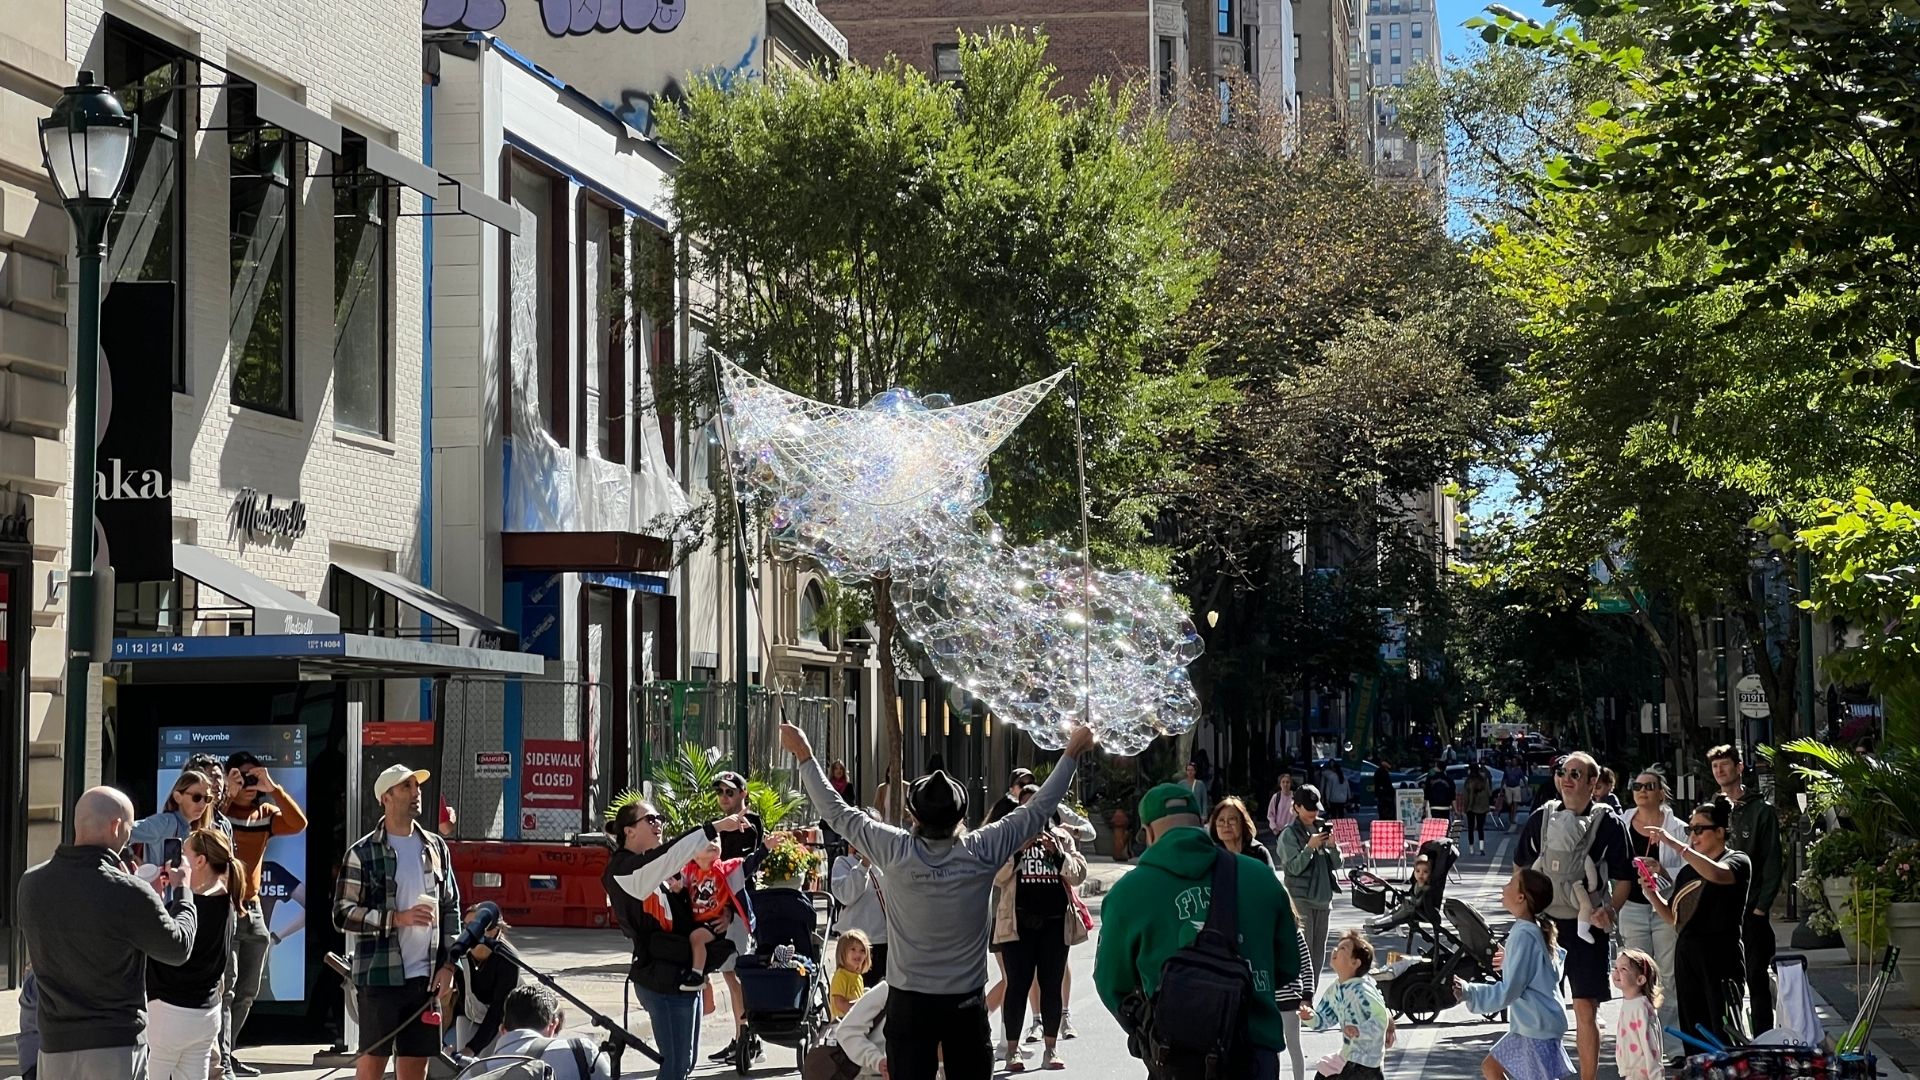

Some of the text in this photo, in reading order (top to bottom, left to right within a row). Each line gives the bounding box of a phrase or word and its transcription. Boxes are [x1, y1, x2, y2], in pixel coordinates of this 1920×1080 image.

[235, 486, 307, 544] Madewell
[116, 643, 184, 653] 9 12 21 42
[192, 733, 230, 743] Wycombe
[295, 729, 301, 739] 2
[295, 751, 301, 760] 5
[525, 752, 581, 767] SIDEWALK
[532, 773, 573, 787] CLOSED
[259, 884, 288, 897] USE.
